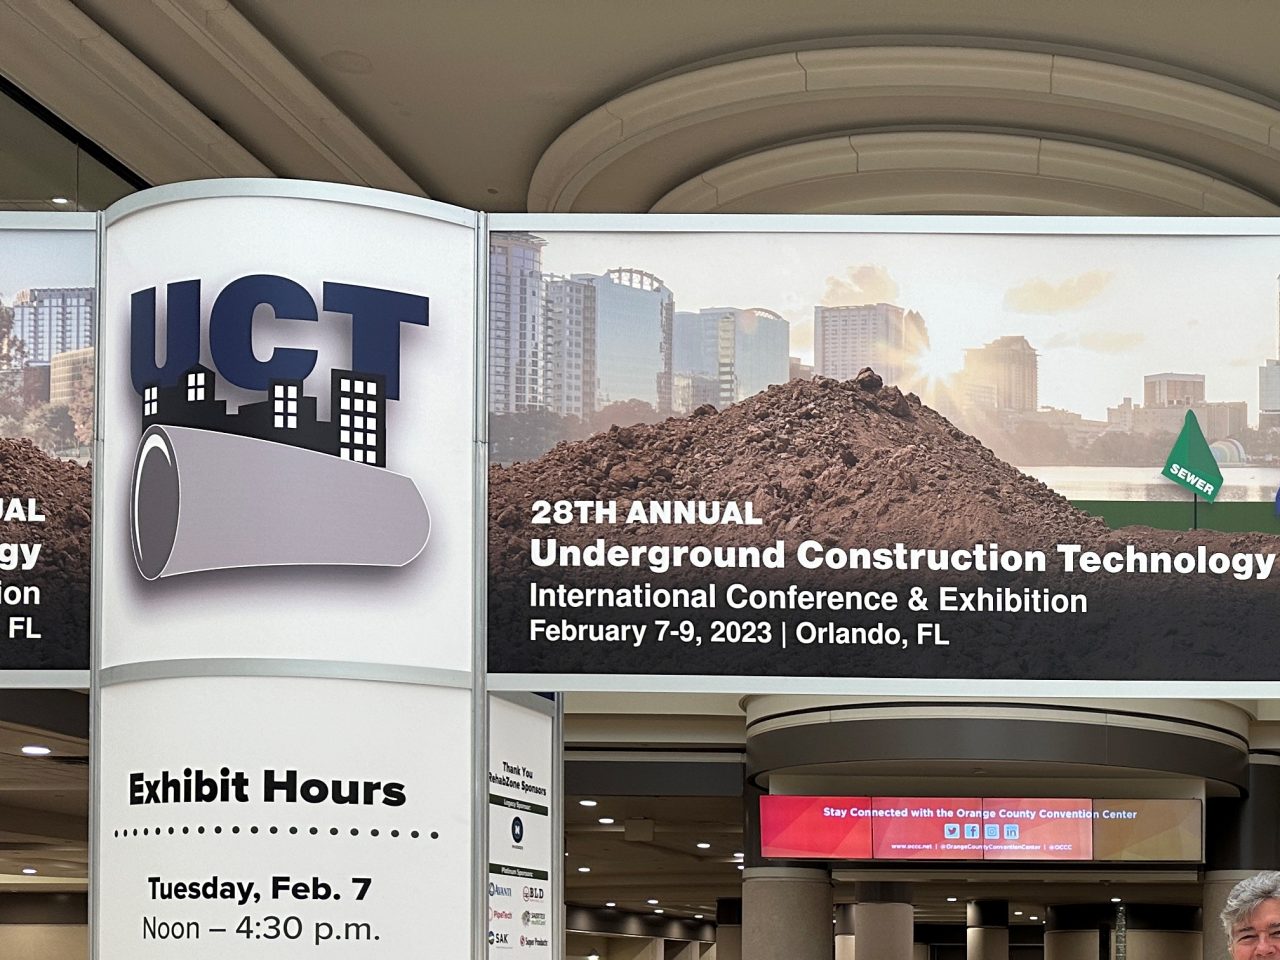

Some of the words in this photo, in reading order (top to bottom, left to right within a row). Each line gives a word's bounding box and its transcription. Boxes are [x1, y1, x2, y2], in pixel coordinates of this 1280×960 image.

[131, 274, 429, 401] UCT
[1169, 461, 1215, 497] SEWER
[0, 498, 46, 522] AL
[531, 501, 617, 525] 28TH
[627, 501, 763, 525] ANNUAL
[530, 538, 788, 572] Underground
[798, 540, 1047, 573] Construction
[1056, 543, 1276, 580] Technology
[0, 580, 41, 605] on
[530, 583, 717, 608] International
[726, 584, 898, 612] Conference
[908, 588, 928, 612] &
[940, 586, 1088, 614] Exhibition
[9, 616, 42, 638] FL
[530, 620, 646, 647] February
[654, 621, 702, 646] 7-9,
[710, 622, 773, 645] 2023
[796, 623, 906, 648] Orlando,
[917, 624, 949, 646] FL
[503, 761, 520, 776] Thank
[521, 767, 533, 779] You
[129, 767, 249, 806] Exhibit
[263, 769, 407, 807] Hours
[521, 780, 547, 797] Sponsors
[823, 807, 847, 819] Stay
[850, 807, 908, 818] Connected
[911, 808, 934, 818] with
[936, 808, 953, 818] the
[957, 809, 996, 820] Orange
[999, 809, 1036, 821] County
[1039, 809, 1099, 820] Convention
[1102, 810, 1138, 820] Center
[148, 876, 261, 905] Tuesday,
[271, 876, 341, 901] Feb.
[351, 877, 372, 901] 7
[530, 887, 544, 900] BLD
[143, 916, 199, 940] Noon
[235, 915, 302, 940] 4:30
[315, 920, 381, 945] p.m.
[496, 933, 508, 944] SAK
